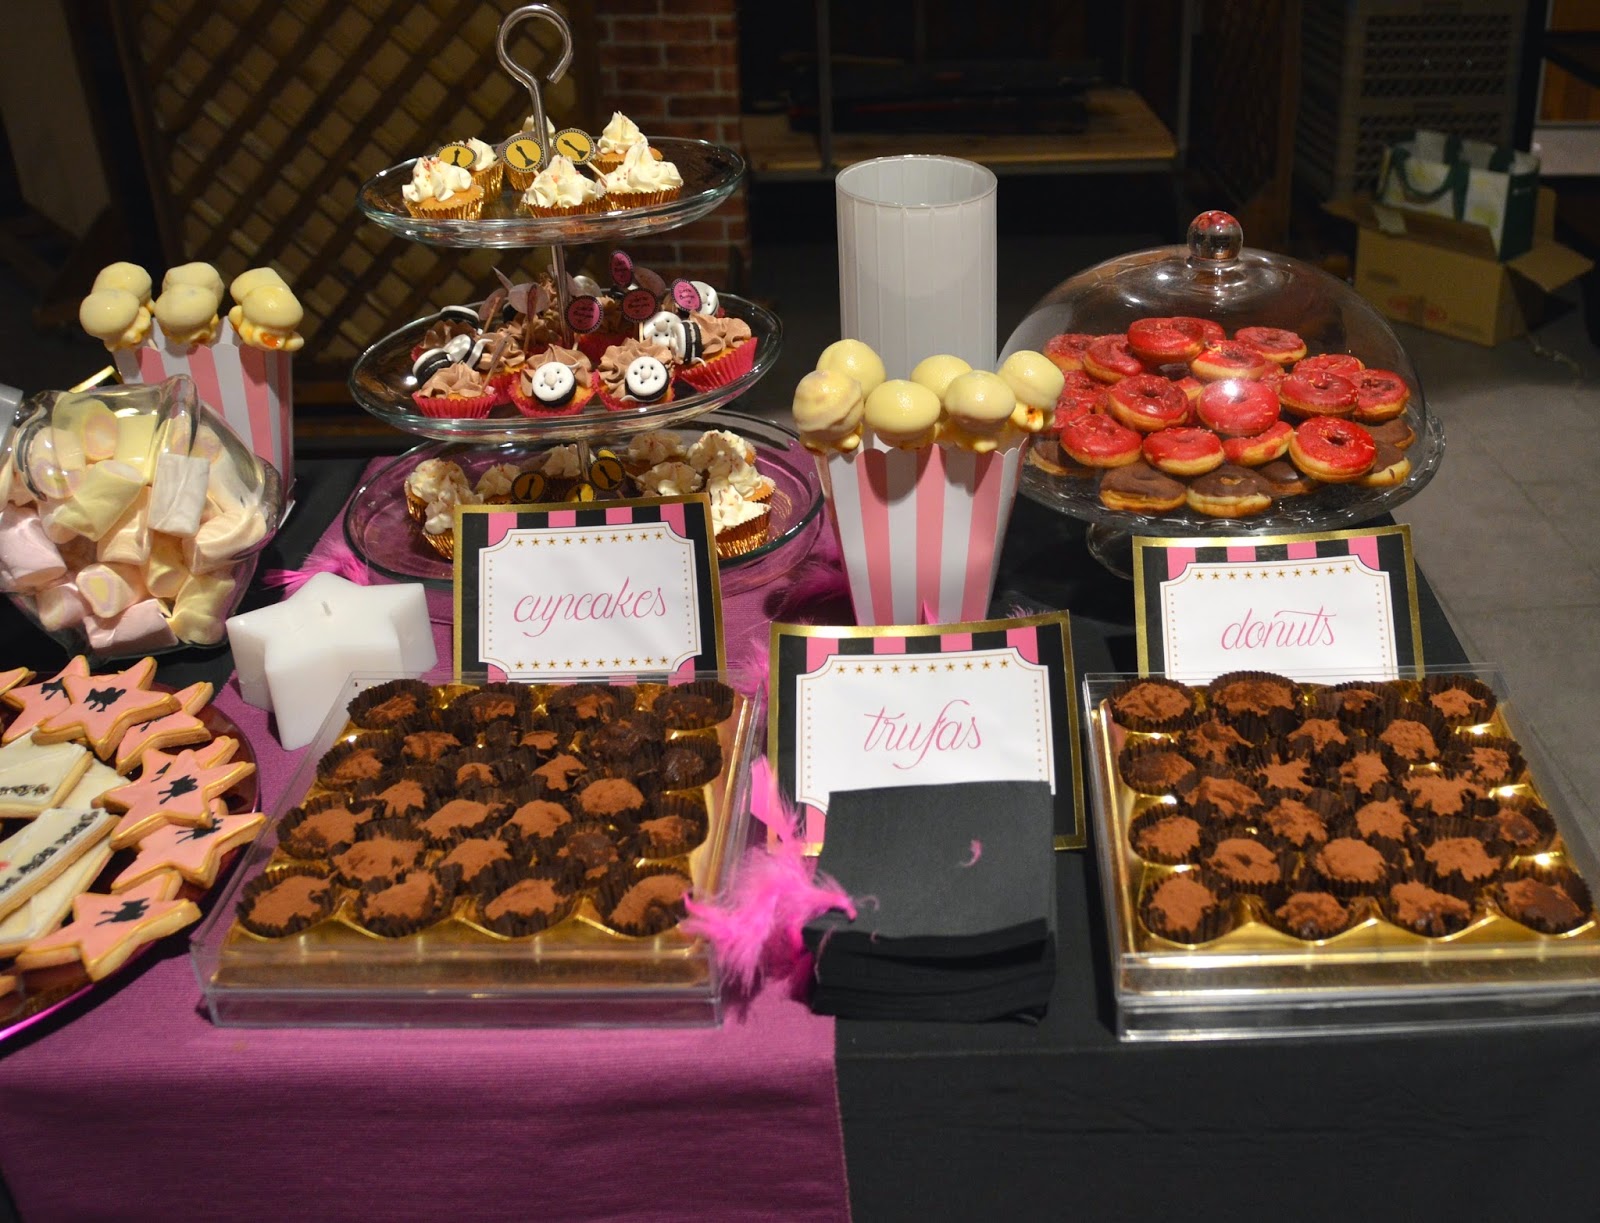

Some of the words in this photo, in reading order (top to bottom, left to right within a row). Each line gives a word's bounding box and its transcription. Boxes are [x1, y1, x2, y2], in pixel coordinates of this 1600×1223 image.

[513, 577, 667, 637] cupcakes
[1220, 606, 1336, 650] donuts
[863, 700, 982, 769] trufas
